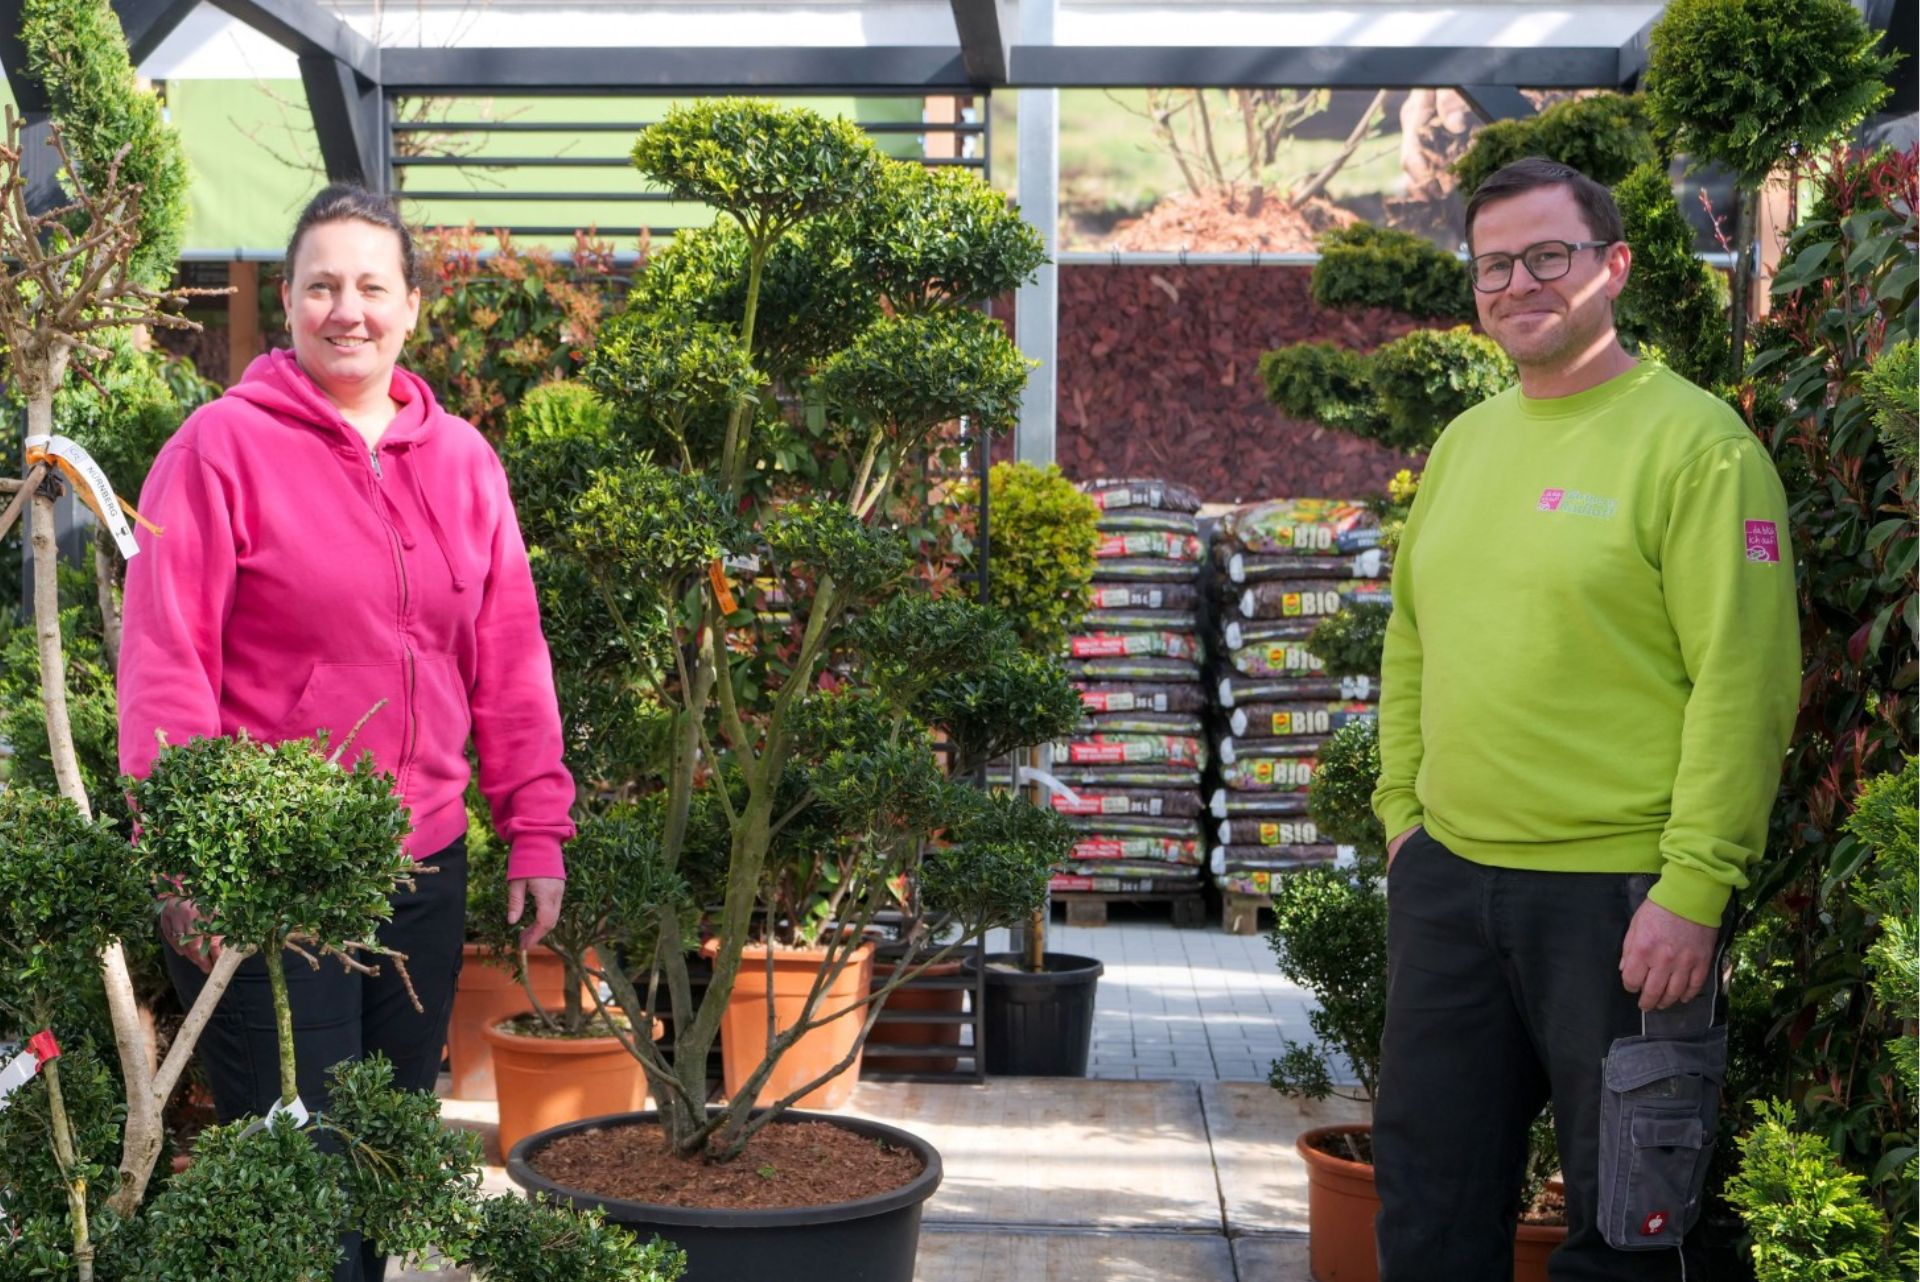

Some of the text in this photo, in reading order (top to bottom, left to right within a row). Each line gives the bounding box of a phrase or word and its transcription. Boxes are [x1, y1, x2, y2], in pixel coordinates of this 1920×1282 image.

[1294, 525, 1332, 549] BIO
[1302, 591, 1340, 616] BIO
[1292, 710, 1330, 734] BIO
[1273, 762, 1312, 785] BIO
[1279, 822, 1317, 844] BIO
